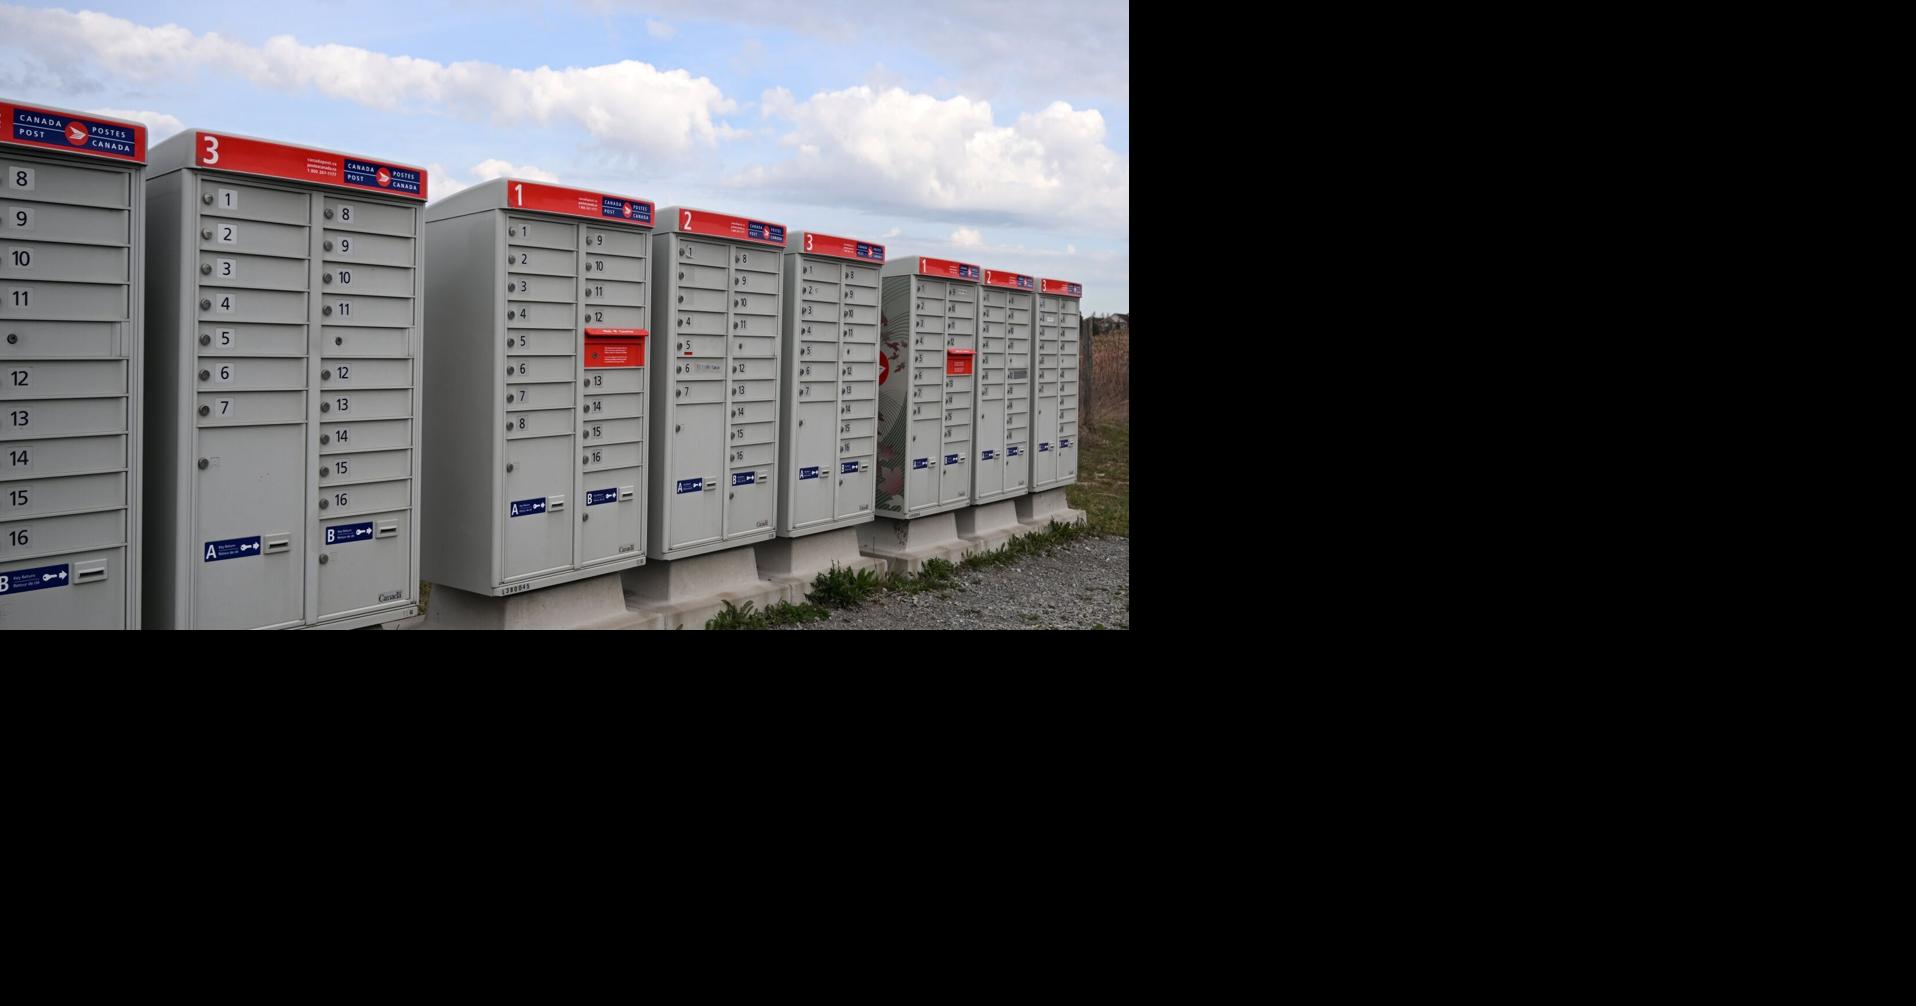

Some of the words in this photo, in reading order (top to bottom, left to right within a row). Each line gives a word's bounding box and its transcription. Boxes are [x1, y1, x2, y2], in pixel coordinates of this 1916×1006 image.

[20, 114, 62, 127] CANADA
[19, 129, 44, 138] POST
[92, 126, 126, 138] POSTES
[92, 139, 130, 152] CANADA
[203, 136, 219, 165] 3
[347, 163, 375, 173] CANADA
[16, 171, 28, 186] 8
[347, 174, 364, 182] POST
[393, 171, 415, 180] POSTES
[393, 182, 417, 190] CANADA
[225, 192, 230, 206] 1
[515, 184, 523, 206] 1
[16, 211, 27, 226] 9
[342, 208, 350, 221] 8
[684, 211, 692, 230] 2
[223, 228, 232, 241] 2
[522, 226, 526, 236] 1
[341, 239, 349, 252] 9
[597, 236, 603, 245] 9
[806, 234, 813, 250] 3
[688, 248, 692, 256] 1
[12, 251, 30, 266] 10
[521, 254, 527, 264] 2
[743, 254, 747, 263] 8
[222, 262, 231, 275] 3
[595, 261, 604, 271] 10
[922, 259, 926, 273] 1
[339, 271, 351, 284] 10
[742, 276, 746, 285] 9
[987, 271, 992, 283] 2
[521, 281, 527, 292] 3
[1042, 280, 1047, 291] 3
[595, 287, 603, 296] 11
[12, 291, 28, 306] 11
[221, 297, 230, 310] 4
[741, 298, 746, 307] 10
[339, 303, 350, 315] 11
[520, 309, 526, 319] 4
[595, 312, 603, 322] 12
[686, 317, 691, 325] 4
[741, 320, 746, 328] 11
[221, 332, 230, 345] 5
[520, 336, 526, 346] 5
[686, 341, 691, 349] 5
[220, 366, 229, 379] 6
[337, 367, 349, 379] 12
[520, 364, 526, 374] 6
[685, 364, 690, 373] 6
[739, 364, 744, 372] 12
[11, 371, 29, 386] 12
[594, 376, 602, 386] 13
[684, 387, 689, 396] 7
[739, 385, 744, 394] 13
[520, 391, 525, 401] 7
[220, 401, 229, 414] 7
[336, 398, 348, 410] 13
[593, 401, 601, 411] 14
[737, 408, 744, 416] 14
[11, 411, 29, 426] 13
[519, 418, 525, 429] 8
[335, 430, 348, 442] 14
[593, 426, 601, 437] 15
[737, 429, 743, 438] 15
[10, 451, 29, 466] 14
[592, 452, 601, 462] 16
[335, 462, 348, 474] 15
[732, 475, 736, 484] B
[677, 483, 683, 492] A
[9, 490, 28, 506] 15
[335, 493, 347, 506] 16
[587, 493, 592, 504] B
[511, 504, 519, 515] A
[9, 530, 29, 546] 16
[327, 529, 335, 542] B
[206, 544, 217, 559] A
